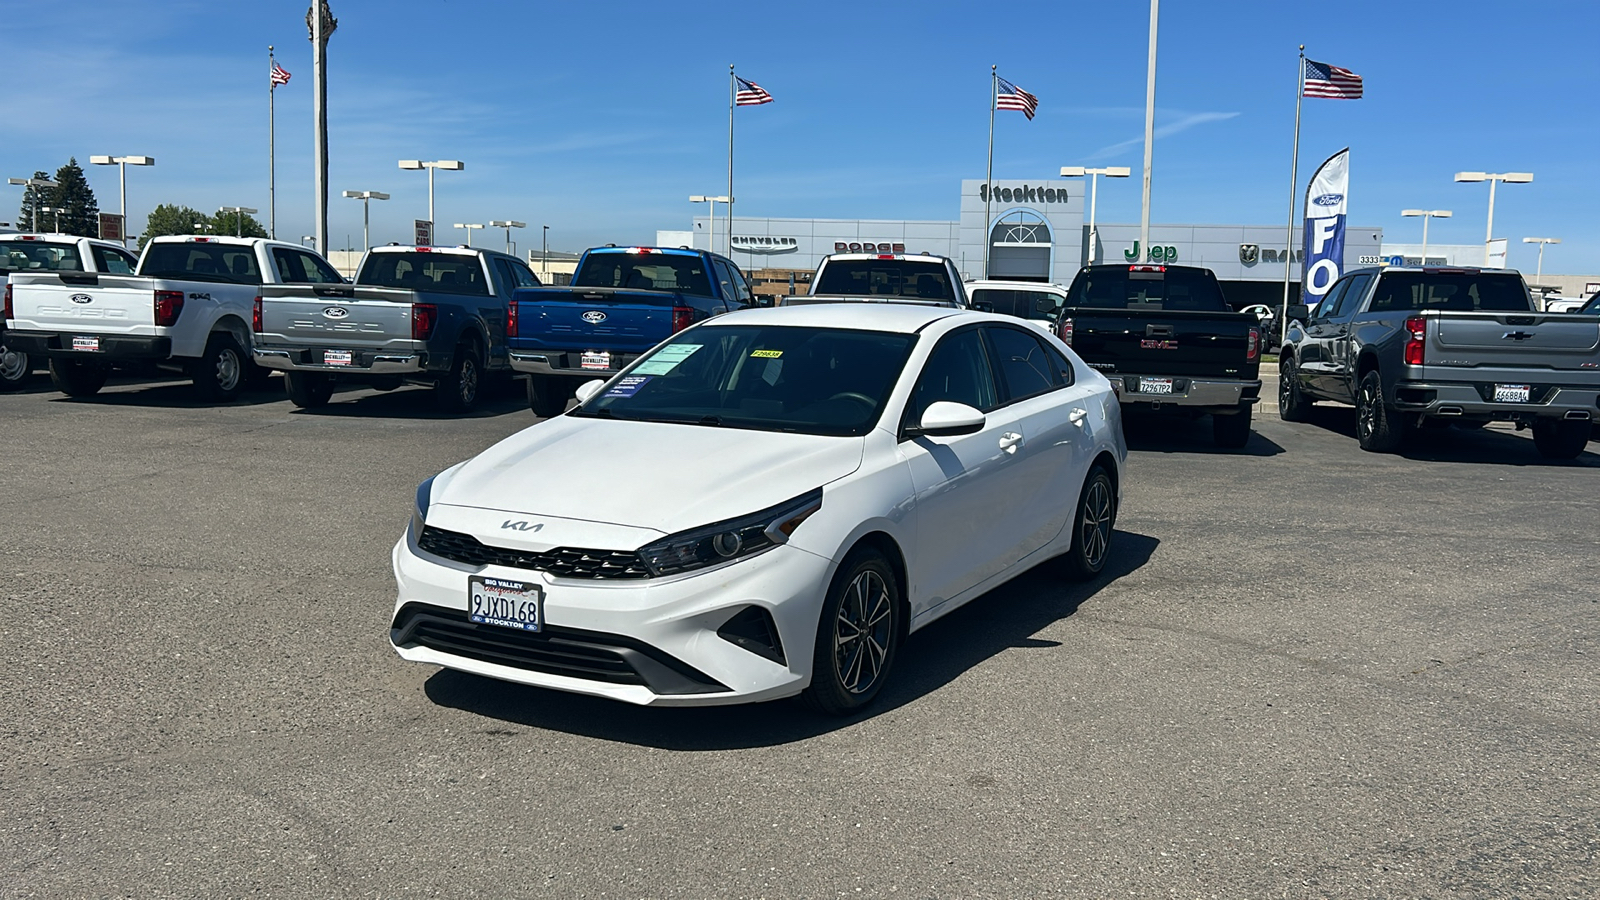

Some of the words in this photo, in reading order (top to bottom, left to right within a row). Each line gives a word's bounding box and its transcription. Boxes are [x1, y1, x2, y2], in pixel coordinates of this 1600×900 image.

[980, 184, 1068, 203] Stockton
[732, 237, 797, 245] CHRYSLER
[835, 242, 906, 253] DODGE
[1124, 240, 1177, 262] Jep
[1360, 256, 1379, 264] 3333
[1141, 340, 1178, 349] GMC
[498, 580, 523, 589] VALLEY
[474, 594, 536, 623] 9JXD168
[485, 618, 524, 629] STOCKTON
